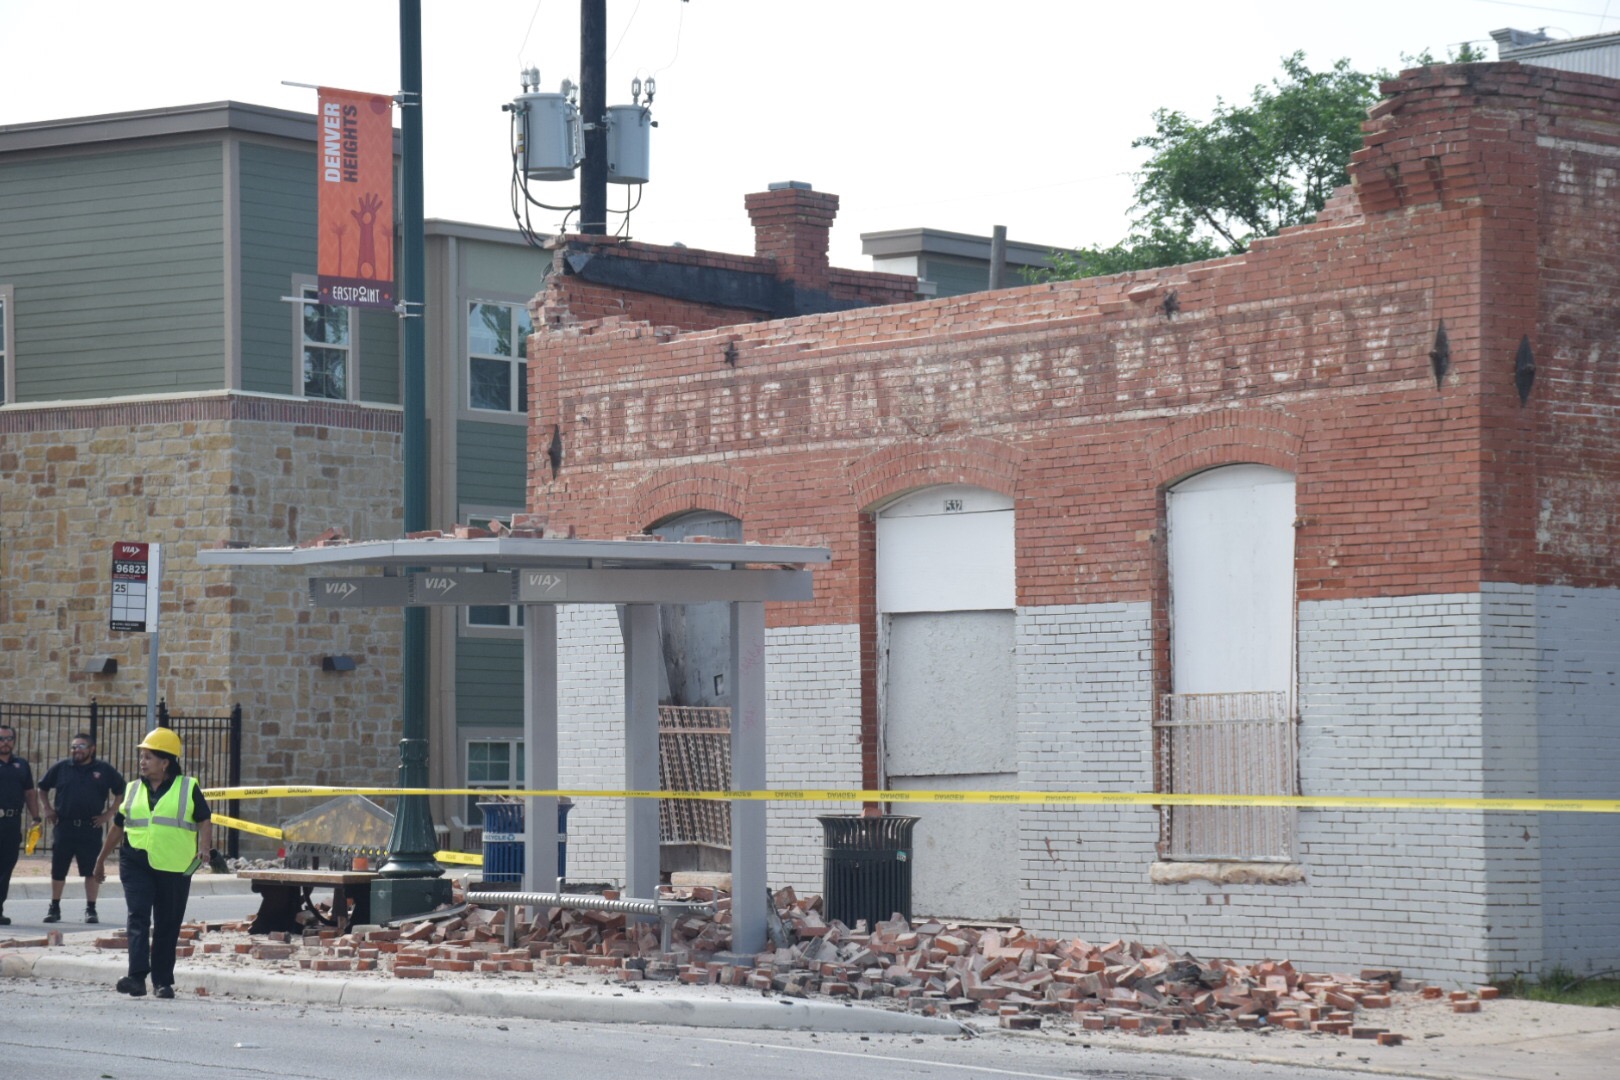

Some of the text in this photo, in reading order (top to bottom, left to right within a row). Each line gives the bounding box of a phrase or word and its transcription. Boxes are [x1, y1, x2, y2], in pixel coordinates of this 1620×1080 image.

[324, 103, 341, 183] DENVER
[343, 104, 358, 183] HEIGHTS
[332, 285, 380, 303] EASTPOINT
[116, 564, 147, 574] 96823
[425, 577, 447, 589] VIA
[529, 574, 551, 586] VIA
[114, 584, 126, 593] 25
[325, 582, 348, 594] VIA
